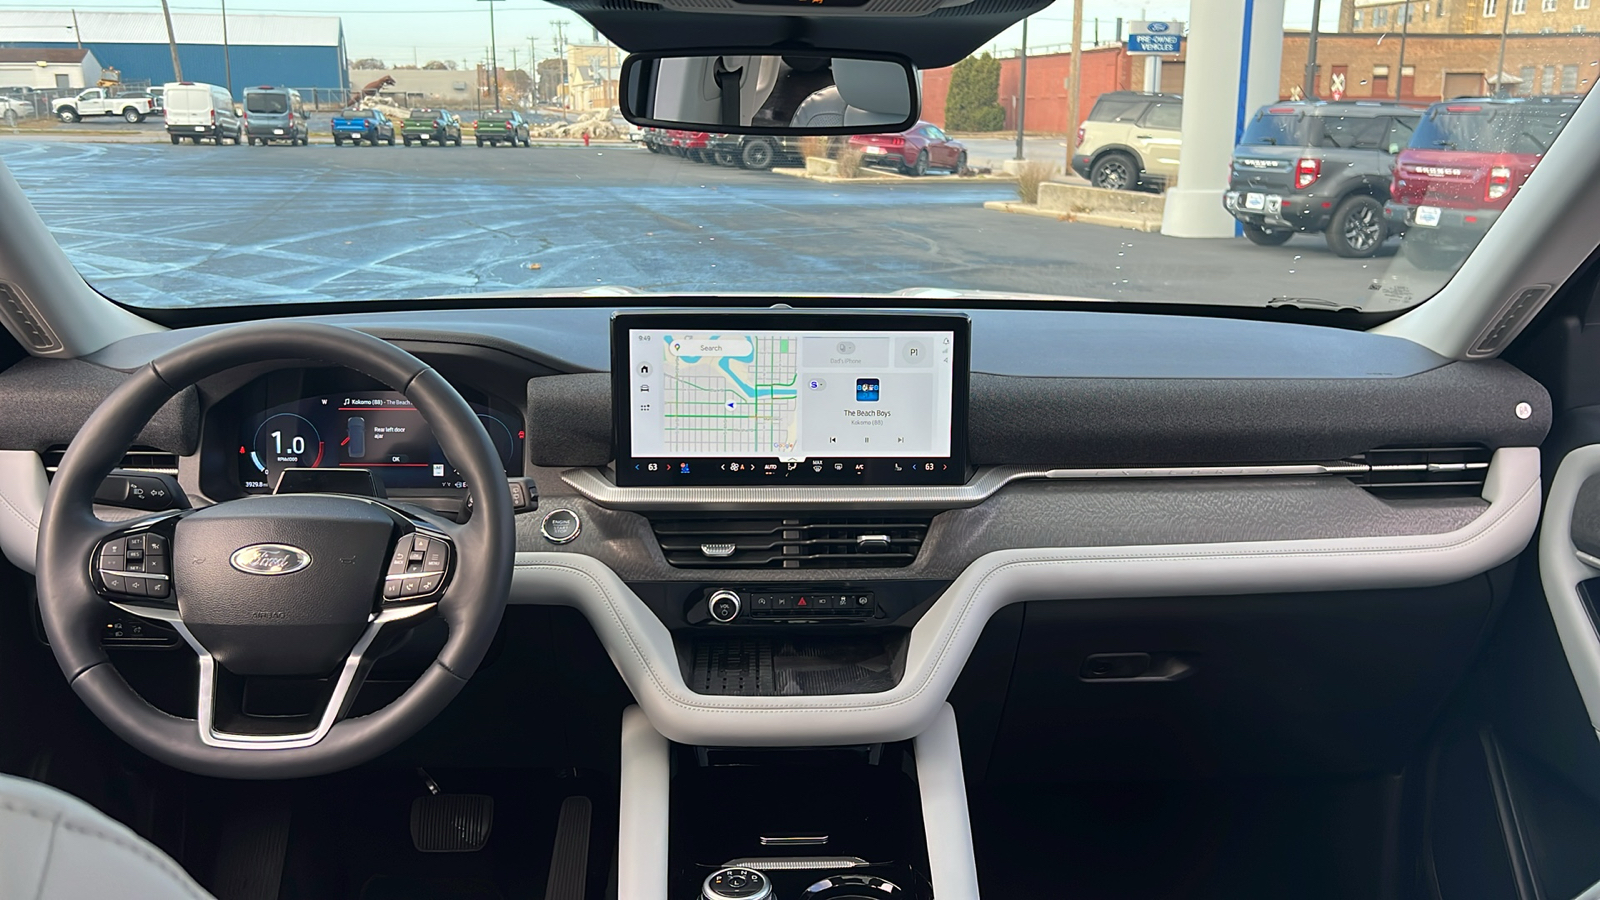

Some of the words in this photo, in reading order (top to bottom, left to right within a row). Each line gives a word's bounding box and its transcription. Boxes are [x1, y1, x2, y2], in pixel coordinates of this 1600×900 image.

[1141, 43, 1174, 51] VEHICLES
[700, 344, 723, 352] Search
[844, 409, 856, 417] The
[857, 409, 876, 417] Beach
[877, 409, 891, 418] Boys
[851, 419, 871, 427] Kokomo
[271, 430, 305, 454] 1.0
[647, 462, 658, 471] 63
[925, 462, 935, 471] 63
